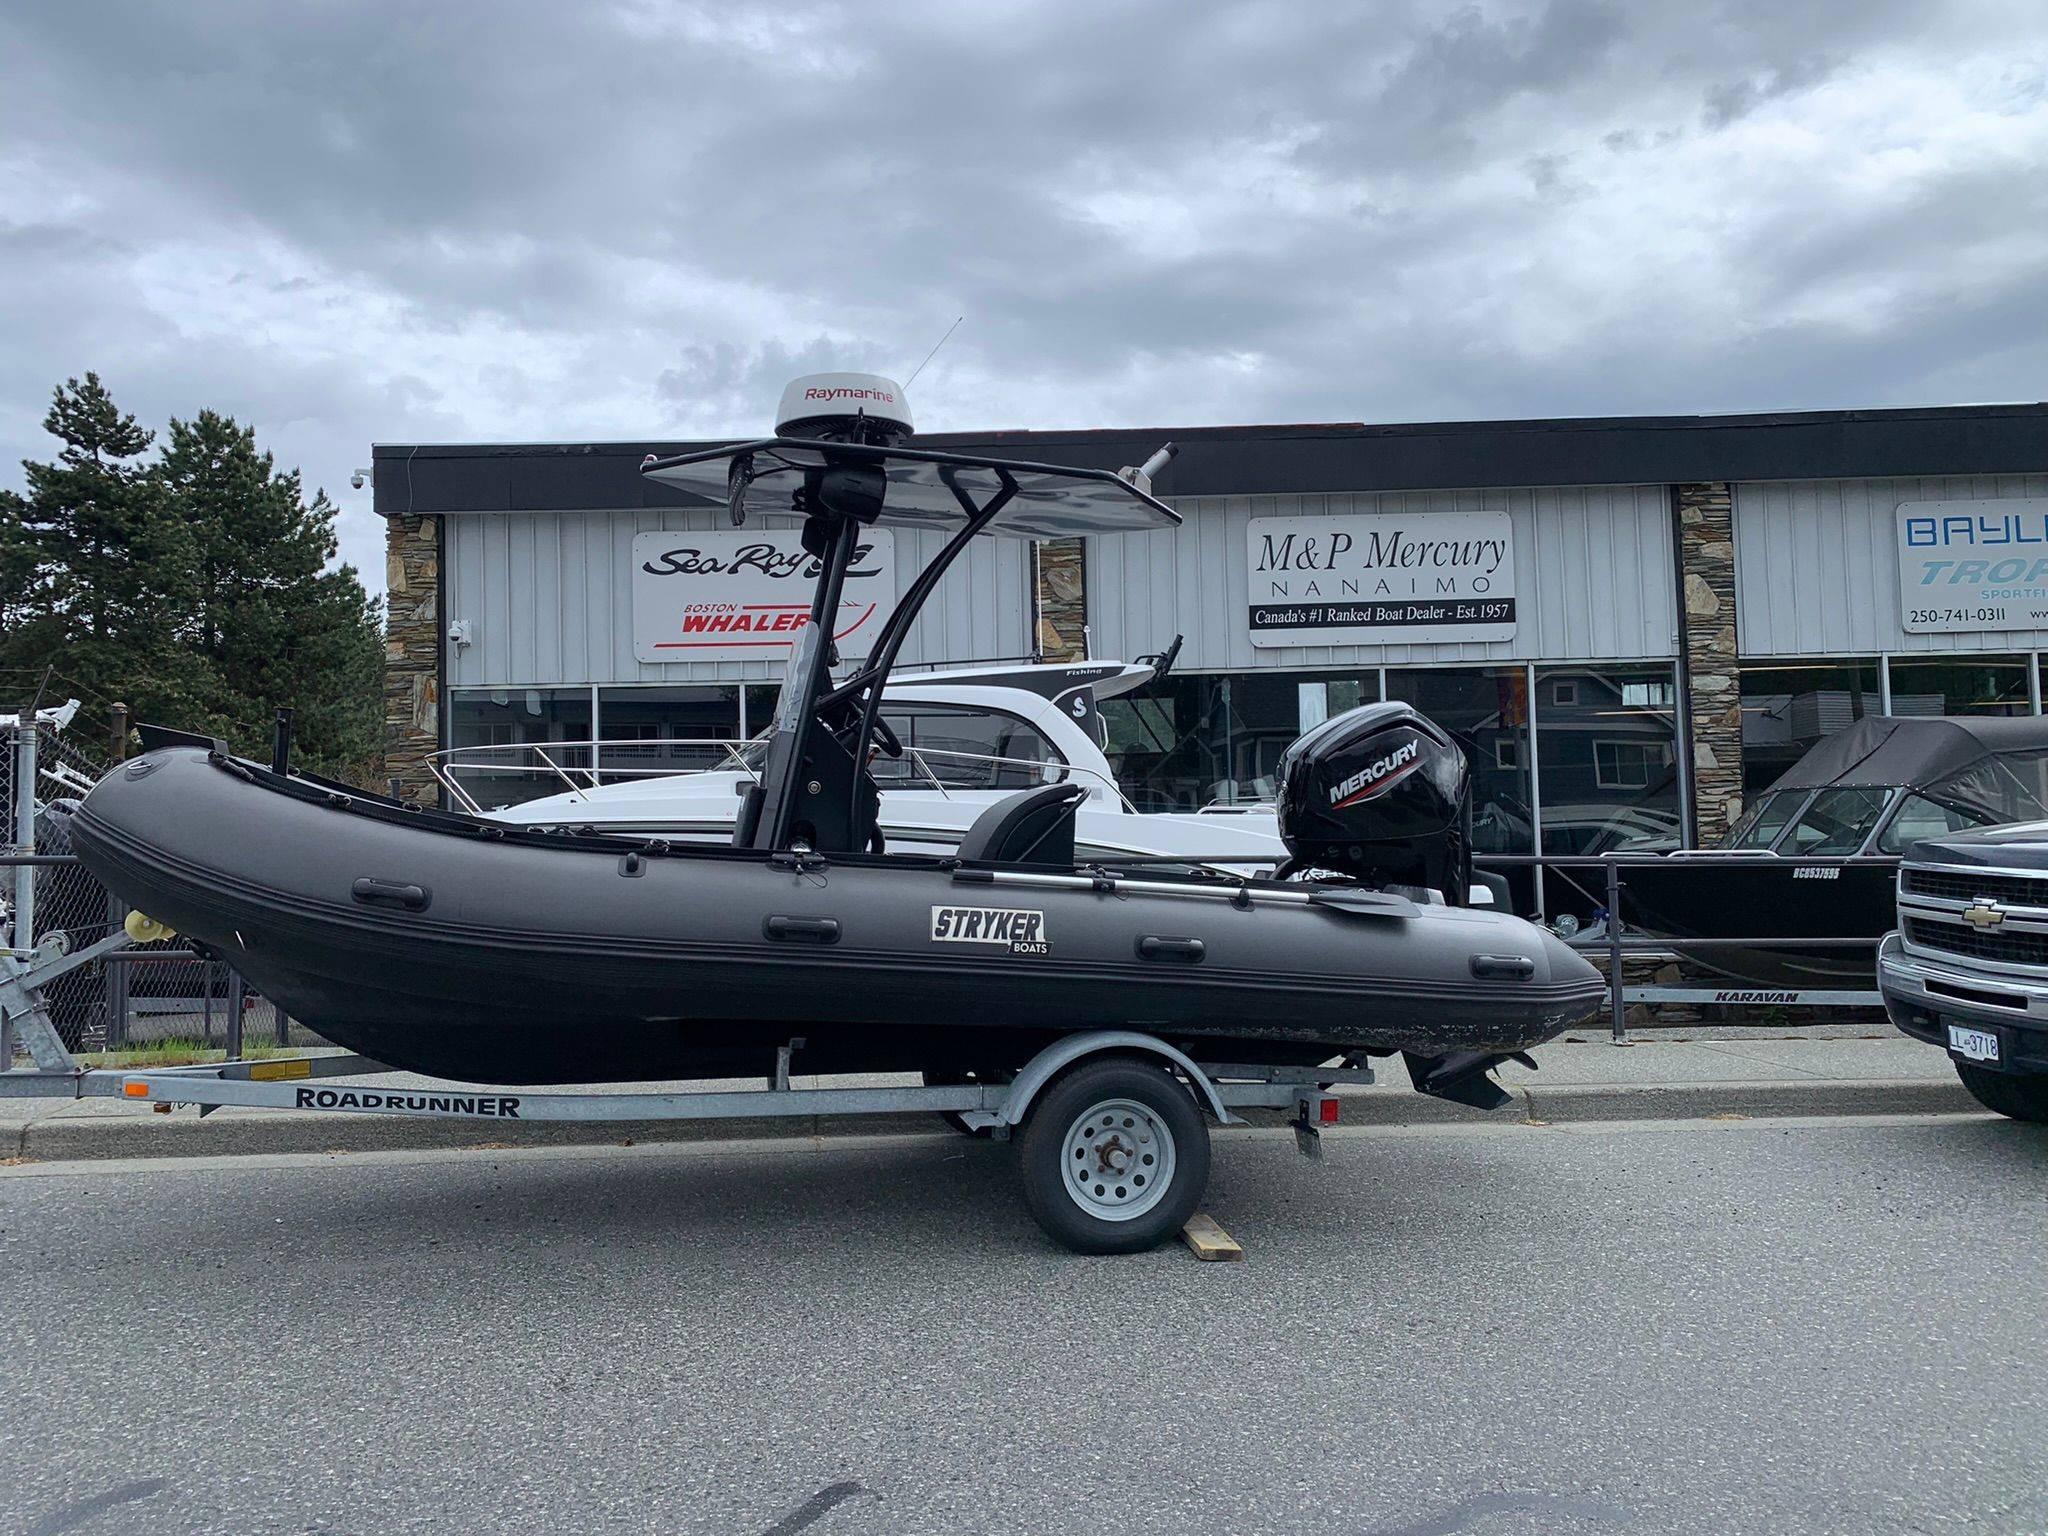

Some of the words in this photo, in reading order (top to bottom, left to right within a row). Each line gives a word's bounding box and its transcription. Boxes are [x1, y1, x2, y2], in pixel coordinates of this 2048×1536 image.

[804, 388, 894, 403] Raymarine
[642, 549, 728, 575] Sea
[1256, 532, 1353, 572] M&P
[1363, 531, 1506, 574] Mercury
[1271, 576, 1490, 597] NANAIMO
[683, 603, 738, 613] BOSTON
[1255, 609, 1307, 624] Canada's
[1309, 608, 1323, 622] #1
[1327, 607, 1372, 622] Ranked
[1376, 607, 1404, 621] Boat
[1406, 605, 1446, 620] Dealer
[1456, 604, 1478, 619] Est.
[1480, 603, 1509, 619] 1957
[1910, 608, 2005, 623] 250-741-0311
[682, 613, 812, 633] WHALER
[1329, 739, 1418, 804] MERCURY
[934, 909, 1042, 941] STRYKER
[1014, 942, 1048, 954] BOATS
[1715, 991, 1799, 1003] KARAVAN
[1969, 1034, 1998, 1057] 3718
[296, 1087, 520, 1118] ROADRUNNER
